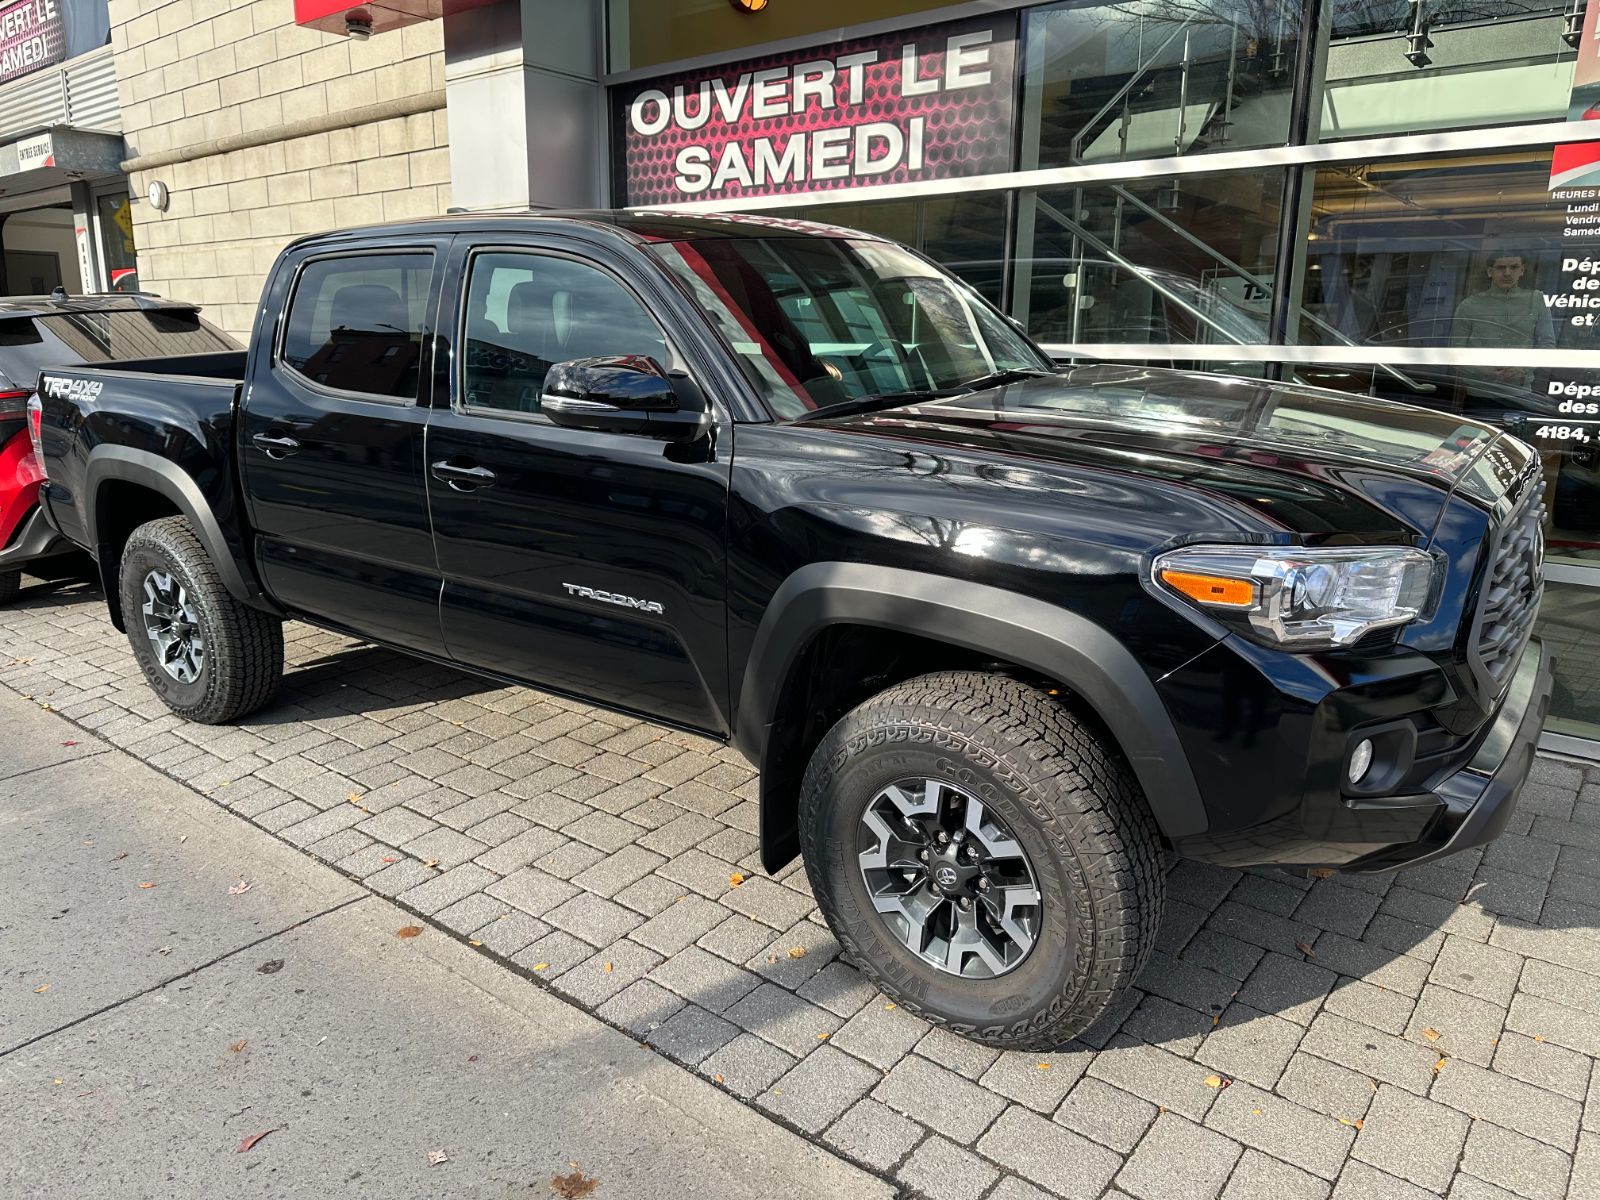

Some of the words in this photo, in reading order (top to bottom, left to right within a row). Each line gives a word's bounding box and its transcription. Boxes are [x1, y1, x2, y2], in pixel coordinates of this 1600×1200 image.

[36, 0, 57, 24] LE
[0, 34, 48, 76] AMEDI
[630, 50, 877, 135] OUVERT
[902, 30, 993, 98] LE
[33, 142, 50, 157] SERVICE
[675, 117, 924, 193] SAMEDI
[1552, 190, 1595, 199] HEURES
[1567, 203, 1599, 213] Lundi
[1562, 257, 1600, 275] Dép
[1543, 294, 1600, 308] Véhic
[1571, 313, 1594, 326] et
[43, 376, 73, 398] TRD
[1548, 381, 1600, 399] Dépa
[1558, 400, 1600, 414] des
[1536, 425, 1590, 443] 4184,
[562, 582, 664, 615] TACOMA
[935, 755, 1069, 948] GOODYEAR
[824, 837, 931, 1003] WRANGLER
